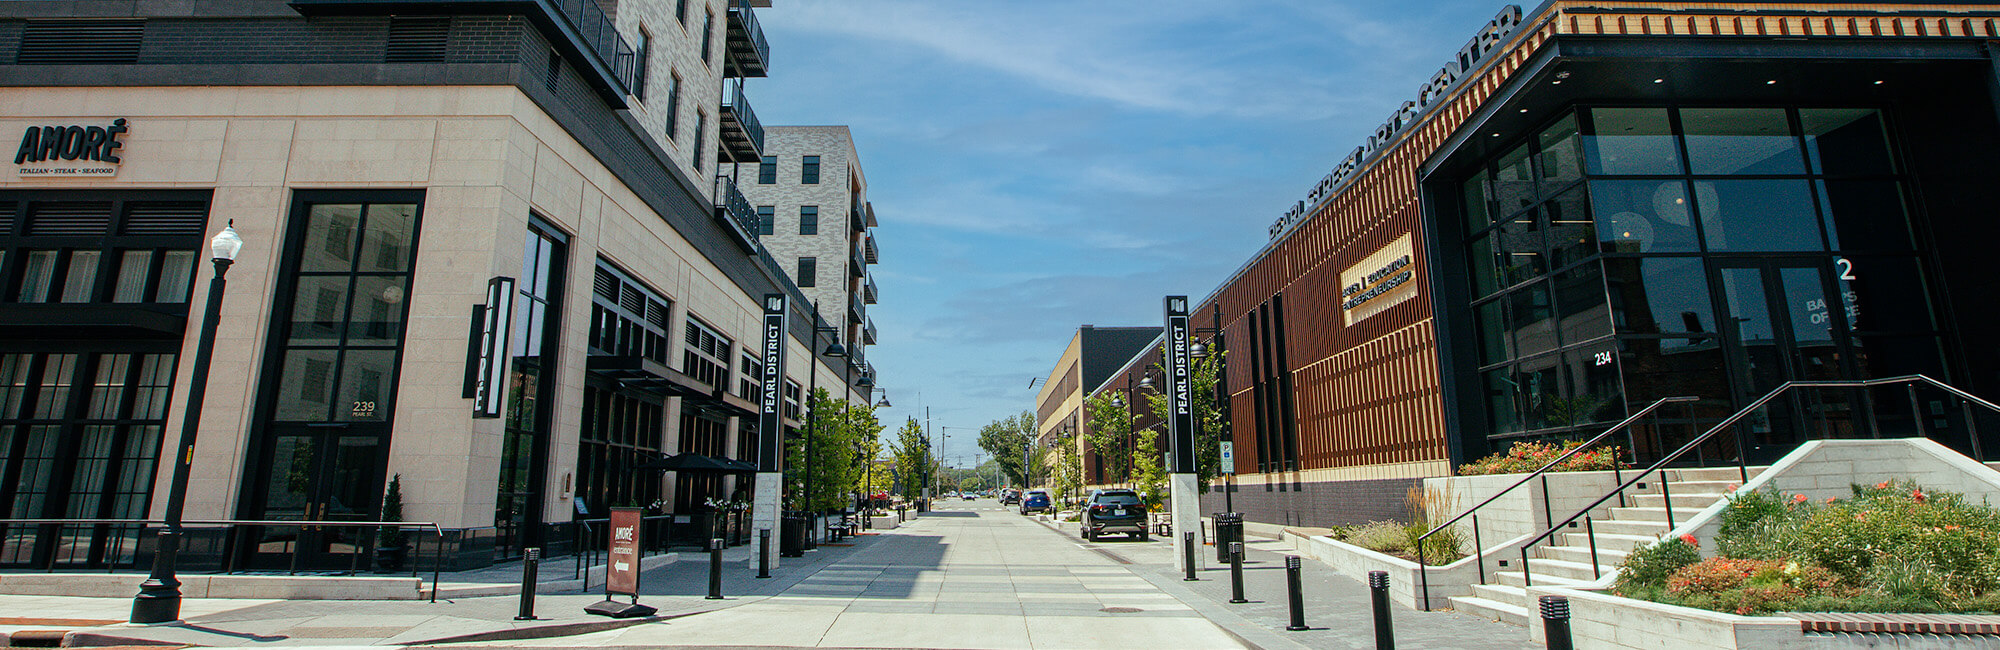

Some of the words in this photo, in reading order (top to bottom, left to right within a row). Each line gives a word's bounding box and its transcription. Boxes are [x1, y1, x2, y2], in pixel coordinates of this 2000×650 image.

[1268, 200, 1304, 240] PEARL
[1307, 146, 1364, 207] STREET
[1364, 101, 1417, 161] ARTS
[1417, 5, 1522, 112] CENTER
[14, 118, 128, 165] AMORÉ
[1367, 255, 1409, 284] EDUCATION
[1343, 270, 1411, 312] ENTREPRENEURSHIP
[767, 324, 779, 375] DISTRICT
[1174, 325, 1186, 376] DISTRICT
[1594, 350, 1611, 366] 234
[352, 401, 375, 411] 239
[765, 377, 775, 413] PEARL
[1177, 378, 1188, 414] PEARL
[615, 525, 633, 540] AMORÉ
